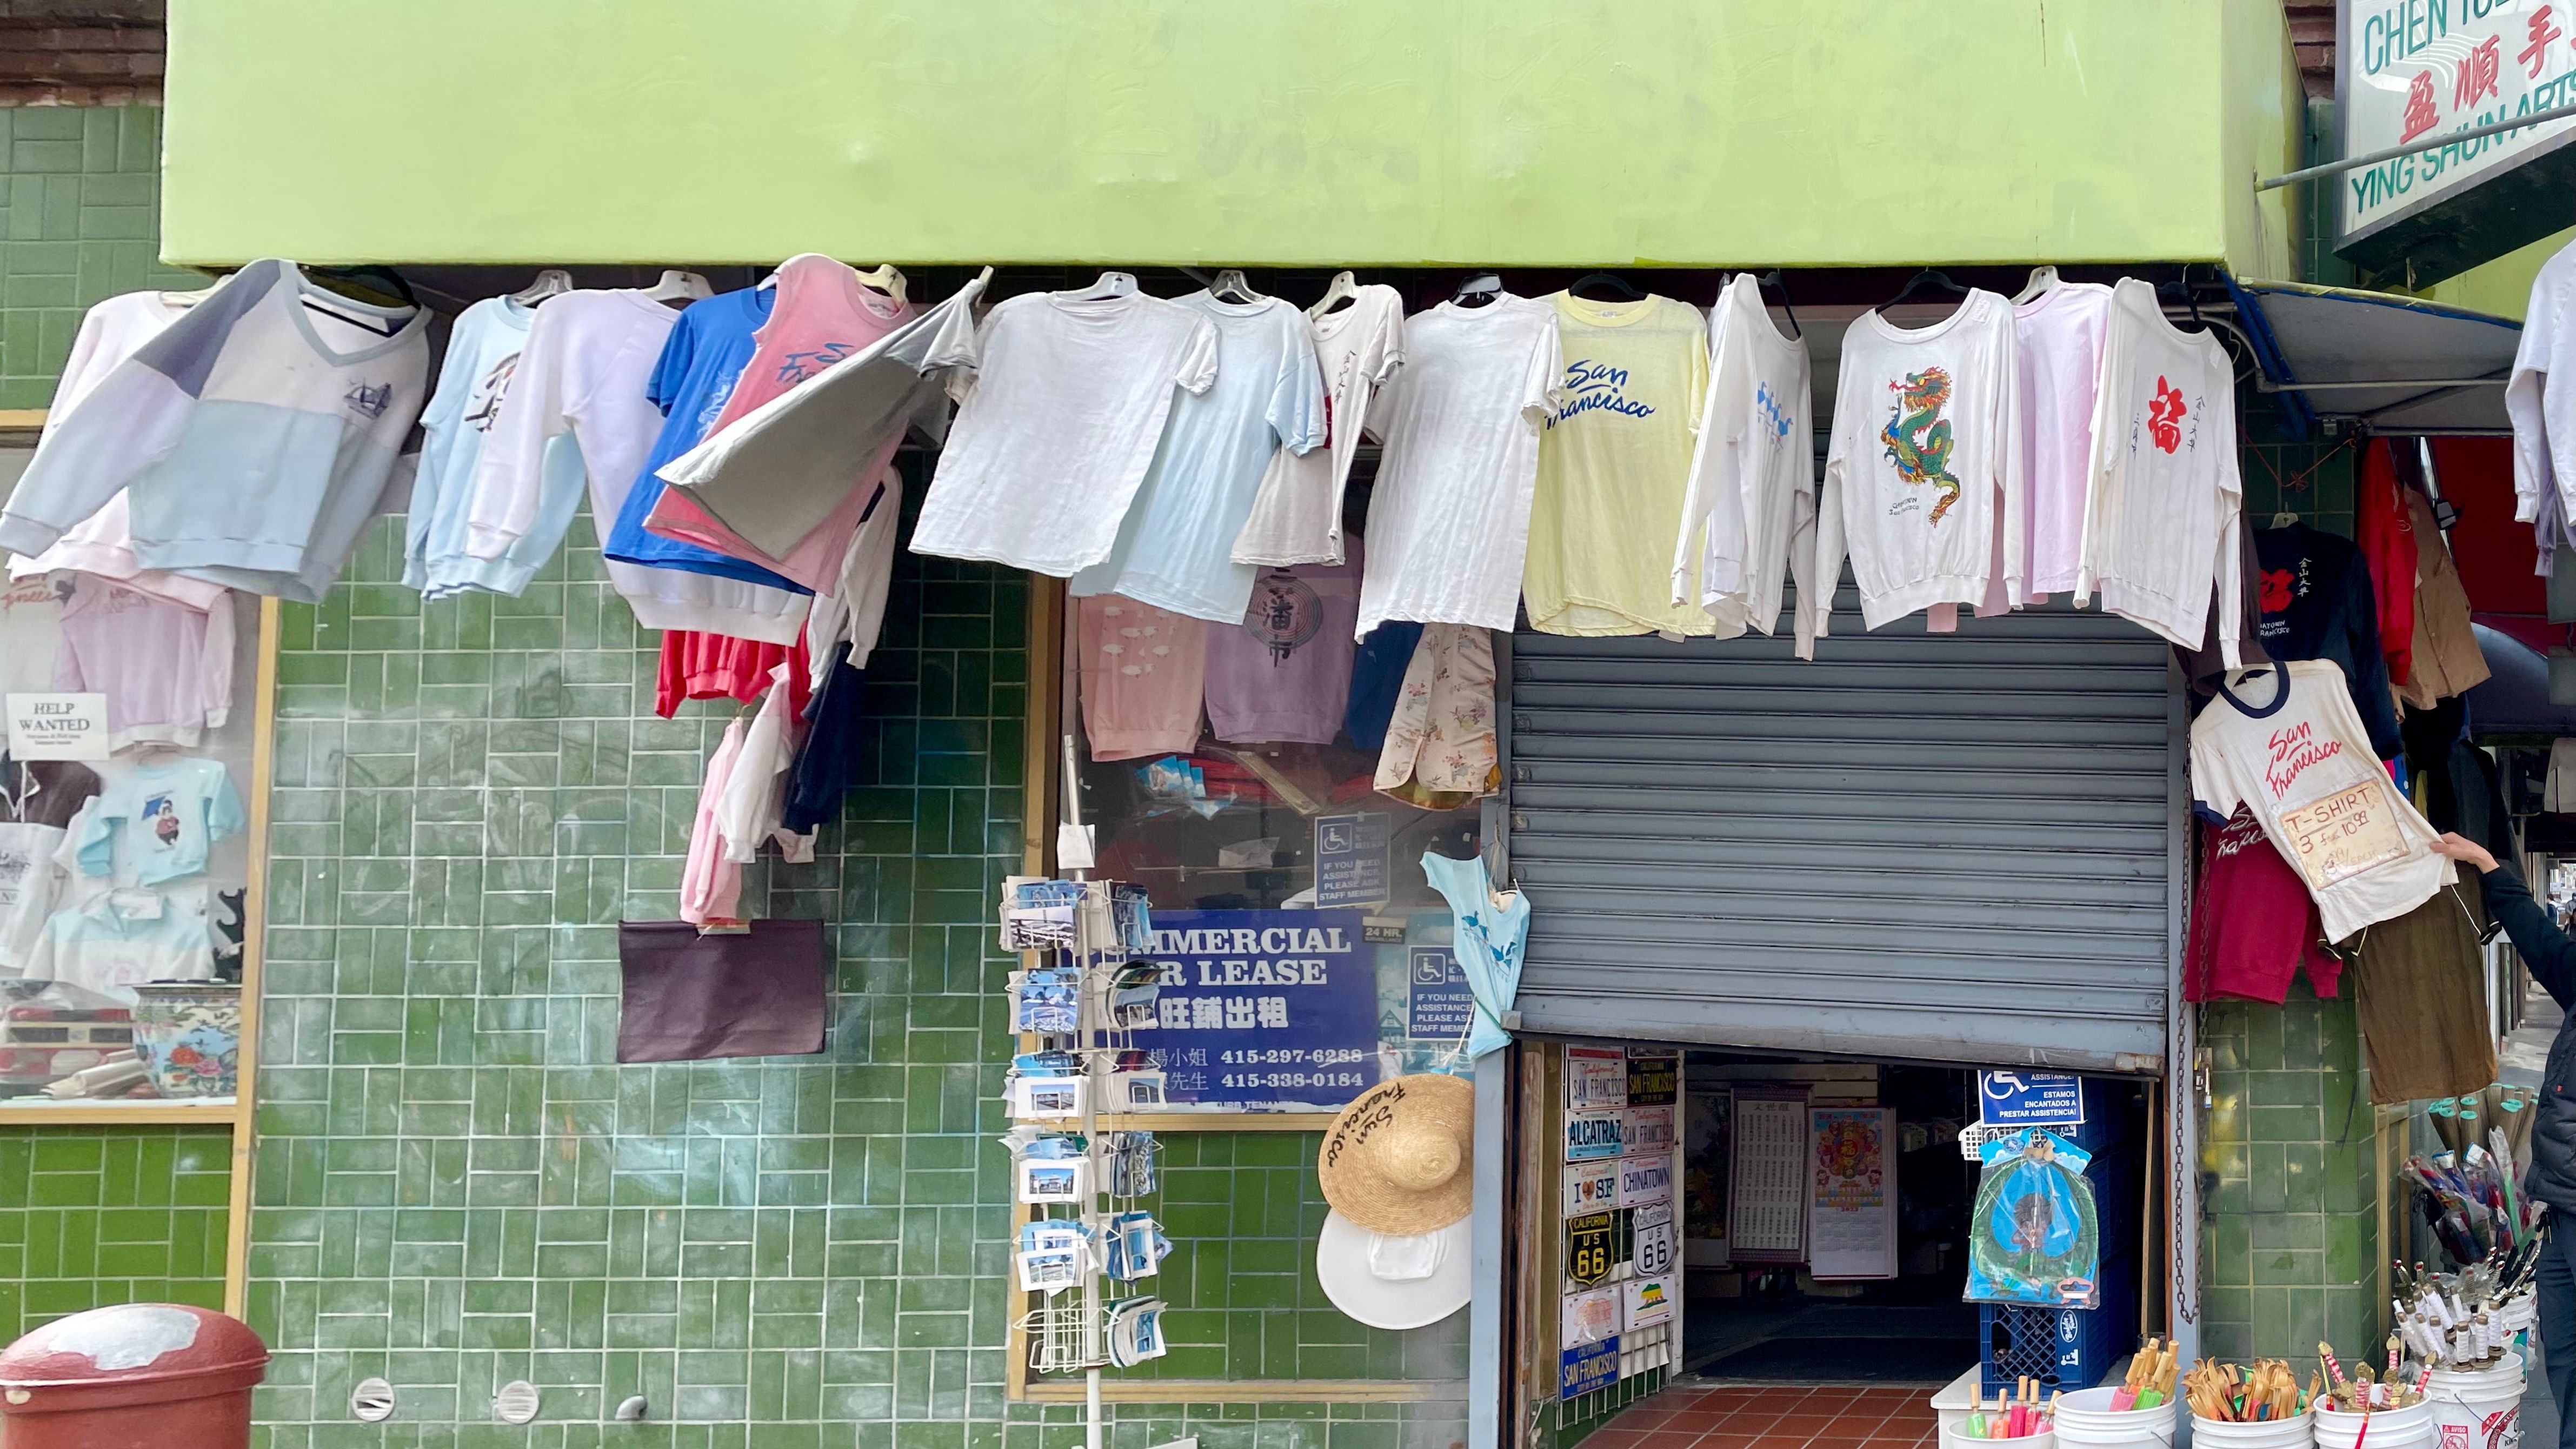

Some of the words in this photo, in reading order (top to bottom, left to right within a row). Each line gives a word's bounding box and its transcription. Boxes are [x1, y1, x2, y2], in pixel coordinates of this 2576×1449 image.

[2364, 0, 2447, 75] CHEN
[2352, 154, 2415, 212] YING
[2421, 104, 2506, 182] SHUN
[1566, 360, 1628, 389] San
[2260, 627, 2290, 637] RANCISCO
[34, 703, 75, 715] HELP
[19, 719, 90, 731] WANTED
[2268, 721, 2312, 762] San
[2266, 740, 2342, 801] Francisco
[2285, 787, 2370, 833] T-SHIRT
[2299, 835, 2314, 855] 3
[1334, 861, 1353, 869] YOU
[1319, 891, 1346, 901] STAFF
[1324, 881, 1359, 890] PLEASE
[1130, 928, 1352, 954] MMERCIAL
[1366, 927, 1380, 936] 24
[1383, 928, 1403, 937] HR.
[1196, 960, 1328, 986] LEASE
[1159, 996, 1289, 1030] 旺鋪出租
[1220, 1049, 1363, 1065] 415-297-6288
[1164, 1072, 1209, 1091] 先生
[1221, 1073, 1364, 1088] 415-338-0184
[1574, 1079, 1587, 1099] SAN
[1590, 1078, 1626, 1098] FRANCISCO
[1629, 1073, 1642, 1094] SAN
[1643, 1072, 1675, 1093] FRANCISCO
[1327, 1082, 1406, 1168] Francisco
[1356, 1104, 1393, 1145] San
[1999, 1109, 2029, 1118] PRESTAR
[2031, 1108, 2076, 1116] ASSISTENCIA!
[1569, 1119, 1622, 1146] ALCATRAZ
[1624, 1126, 1636, 1145] SAN
[1640, 1123, 1674, 1145] FRANCISCO
[1574, 1182, 1581, 1204] I
[1596, 1177, 1615, 1200] SF
[1623, 1167, 1670, 1193] CHINATOWN
[1574, 1214, 1608, 1228] CALIFORNIA
[1577, 1247, 1605, 1278] 66
[1644, 1240, 1667, 1269] 66
[1565, 1361, 1579, 1387] SAN
[1580, 1350, 1618, 1382] FRANCISCO
